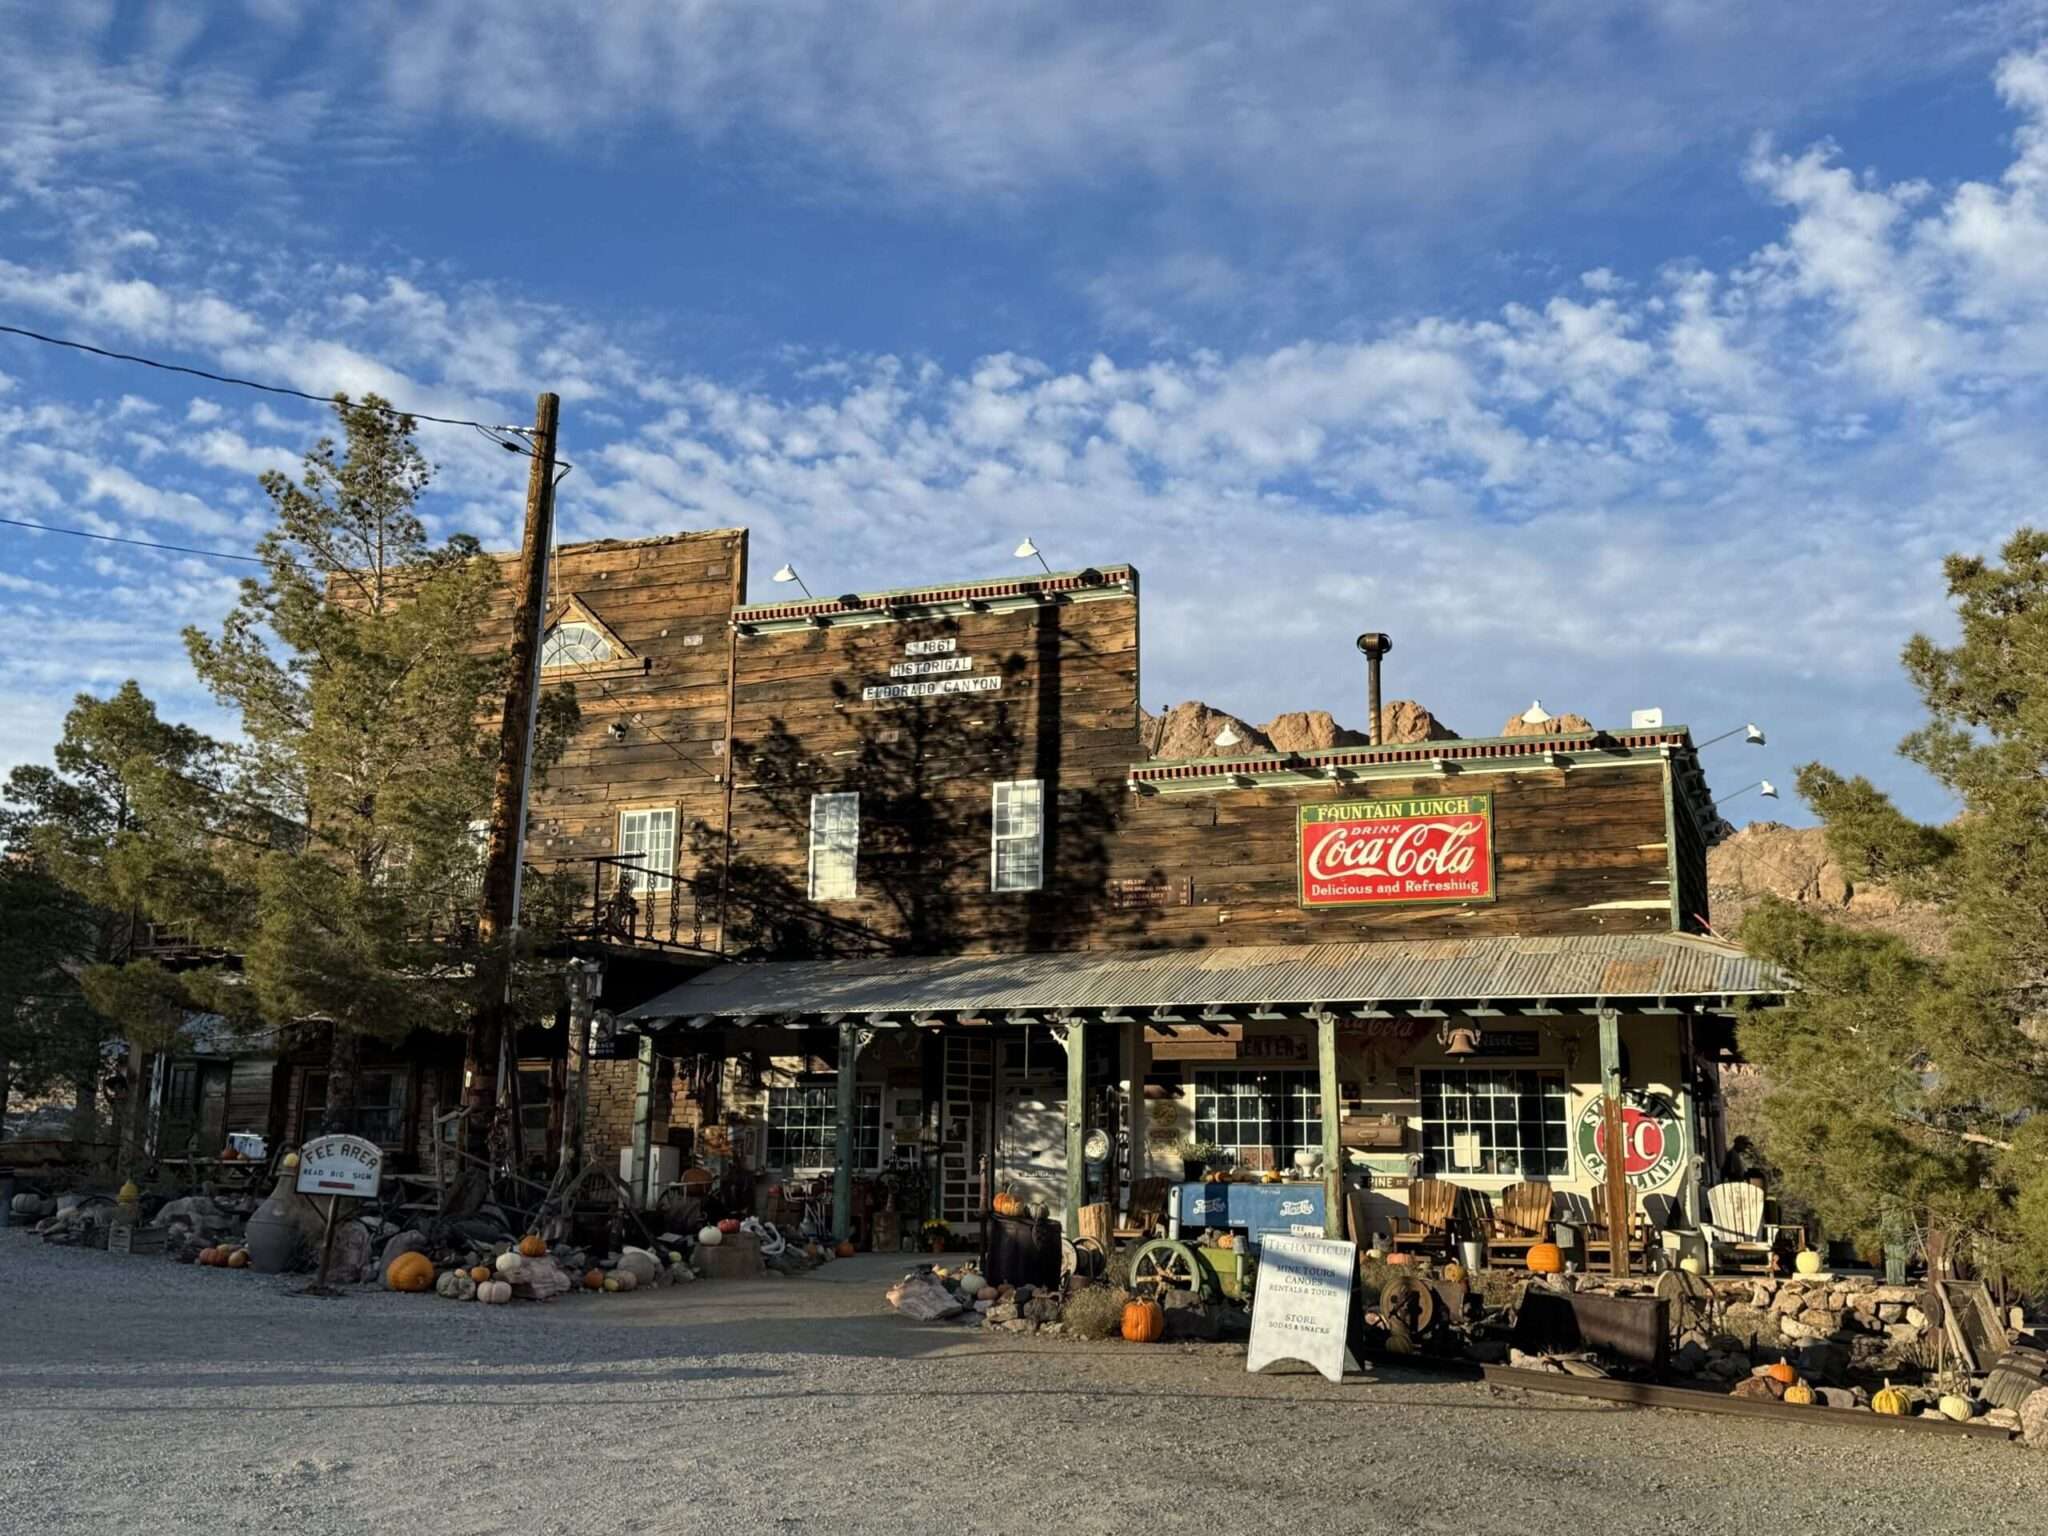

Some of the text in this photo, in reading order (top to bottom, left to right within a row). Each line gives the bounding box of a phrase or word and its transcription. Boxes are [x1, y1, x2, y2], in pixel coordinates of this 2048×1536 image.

[923, 640, 950, 652] 1861
[892, 657, 970, 676] HISTORICAL
[866, 677, 999, 699] ELDORADO CANYON
[1409, 800, 1470, 816] LUNCH
[1351, 824, 1403, 836] DRINK
[1308, 820, 1483, 880] Coca-Cola
[1312, 880, 1479, 896] Delicious and Refreshing
[304, 1143, 378, 1170] FEE AREA
[303, 1168, 372, 1180] READ BIG SIGN
[1285, 1275, 1323, 1286] CANOES
[1311, 1289, 1337, 1297] TOURS
[1285, 1313, 1316, 1325] STORE
